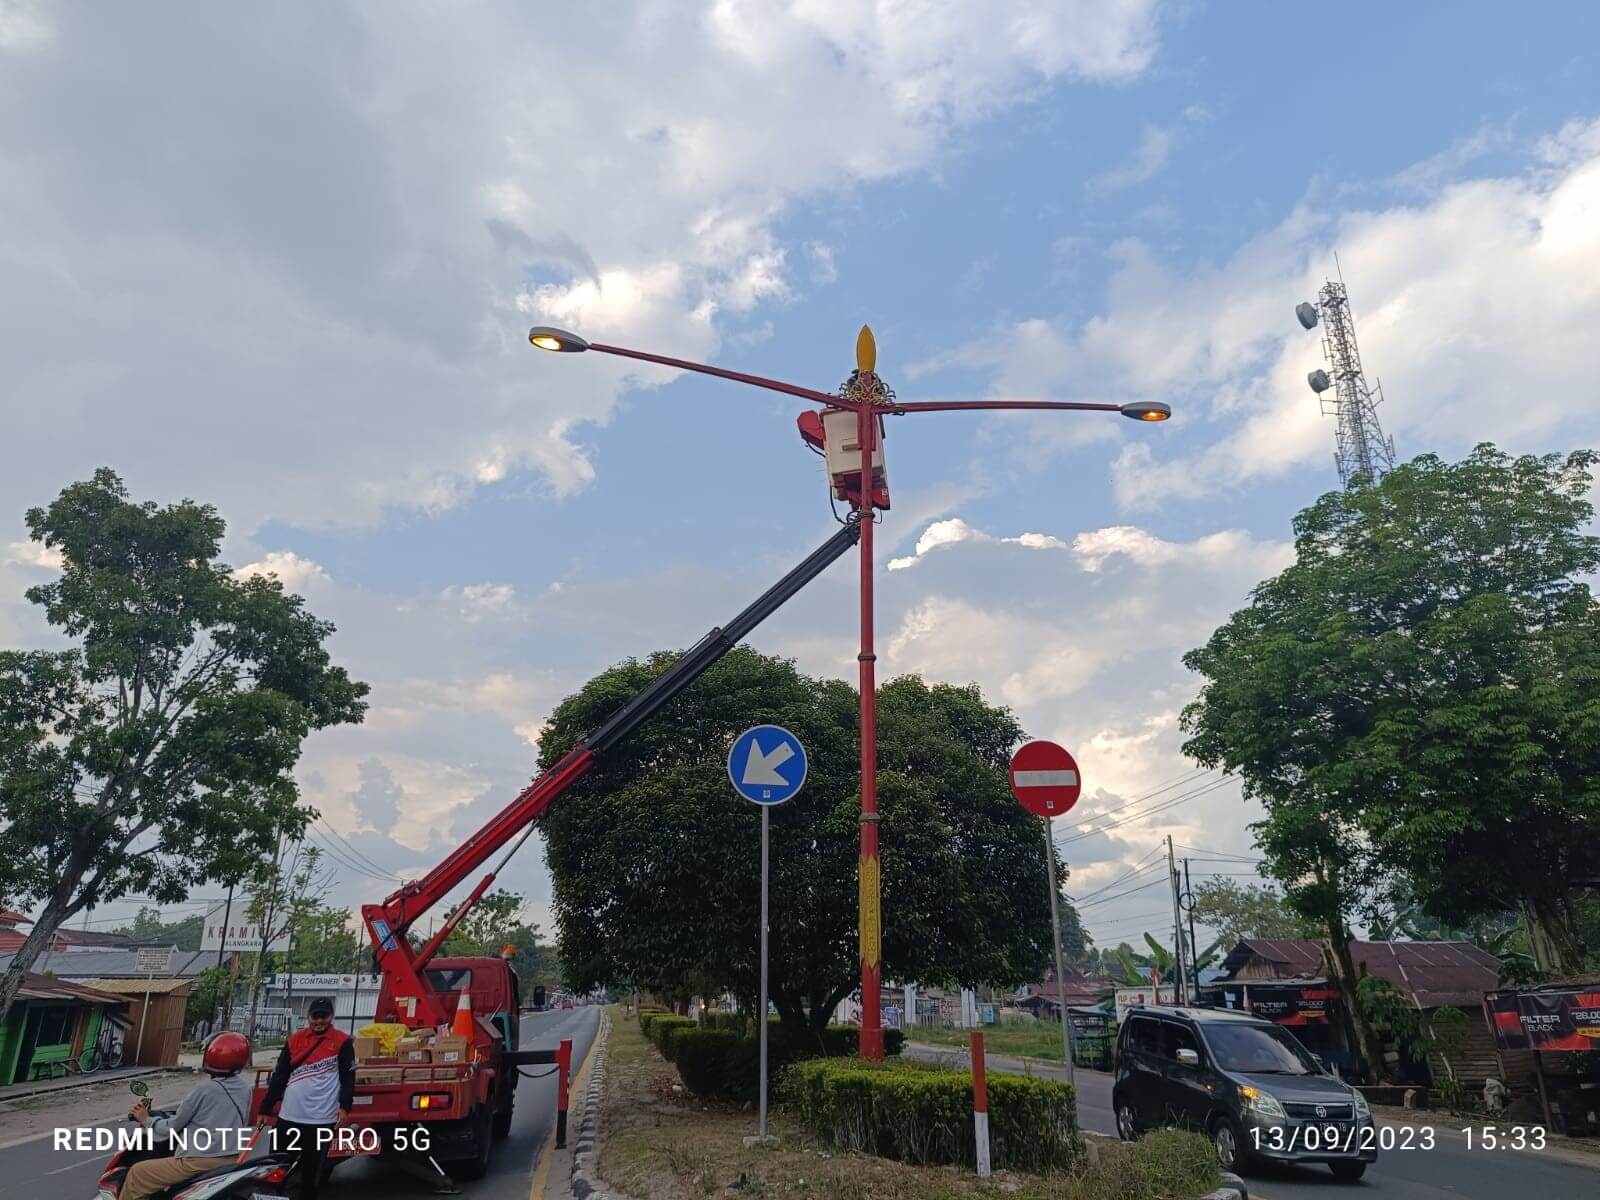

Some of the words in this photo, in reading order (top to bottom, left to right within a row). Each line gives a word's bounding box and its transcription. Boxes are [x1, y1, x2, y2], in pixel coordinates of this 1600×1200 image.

[276, 977, 298, 985] FOD
[300, 977, 338, 985] CONTAINER
[1520, 1015, 1560, 1024] FILTER
